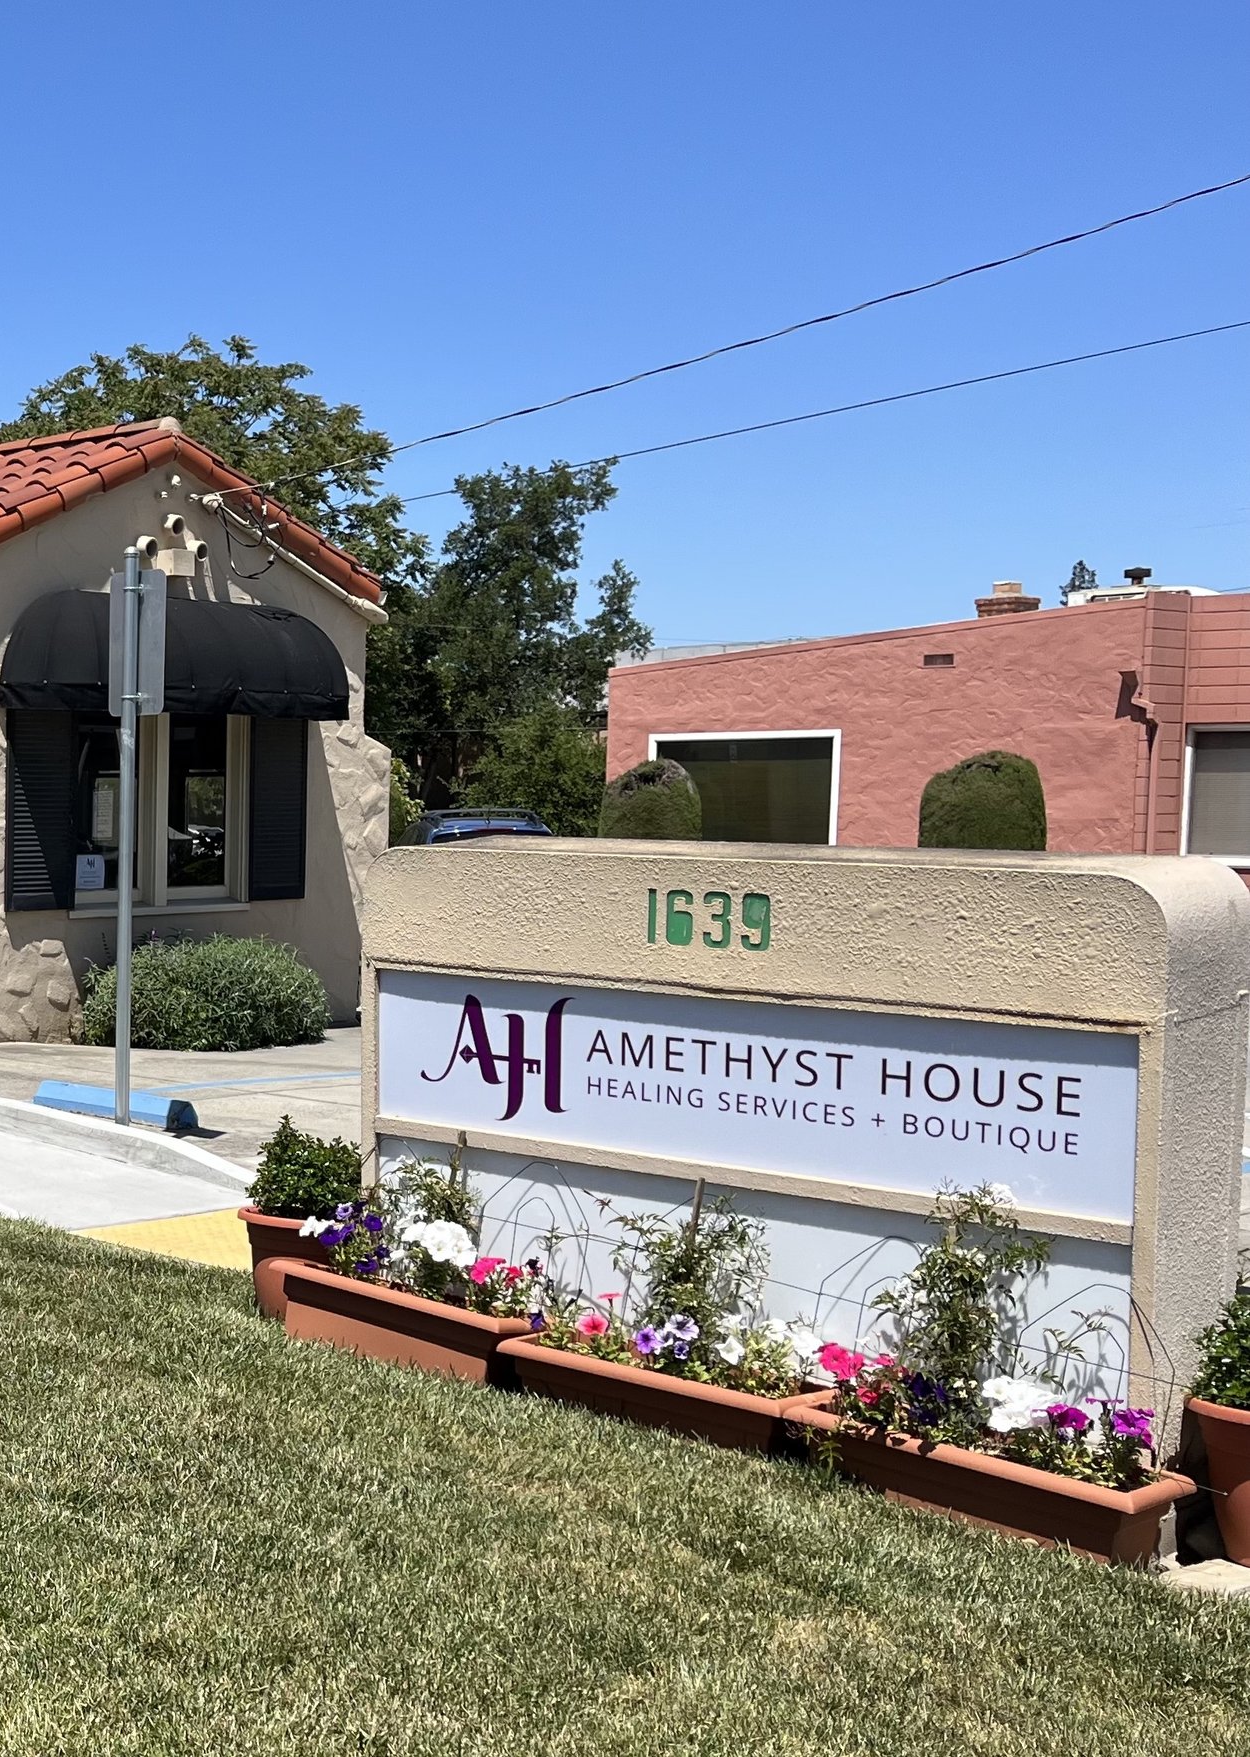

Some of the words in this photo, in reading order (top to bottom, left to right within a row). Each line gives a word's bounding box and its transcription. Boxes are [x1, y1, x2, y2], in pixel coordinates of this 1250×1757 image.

[647, 888, 771, 952] 1639
[421, 994, 577, 1121] AH
[586, 1029, 854, 1090] AMETHYST
[881, 1057, 1082, 1117] HOUSE
[587, 1076, 703, 1109] HEALING
[718, 1091, 855, 1127] SERVICES
[871, 1113, 886, 1127] +
[903, 1113, 1078, 1155] BOUTIQUE
